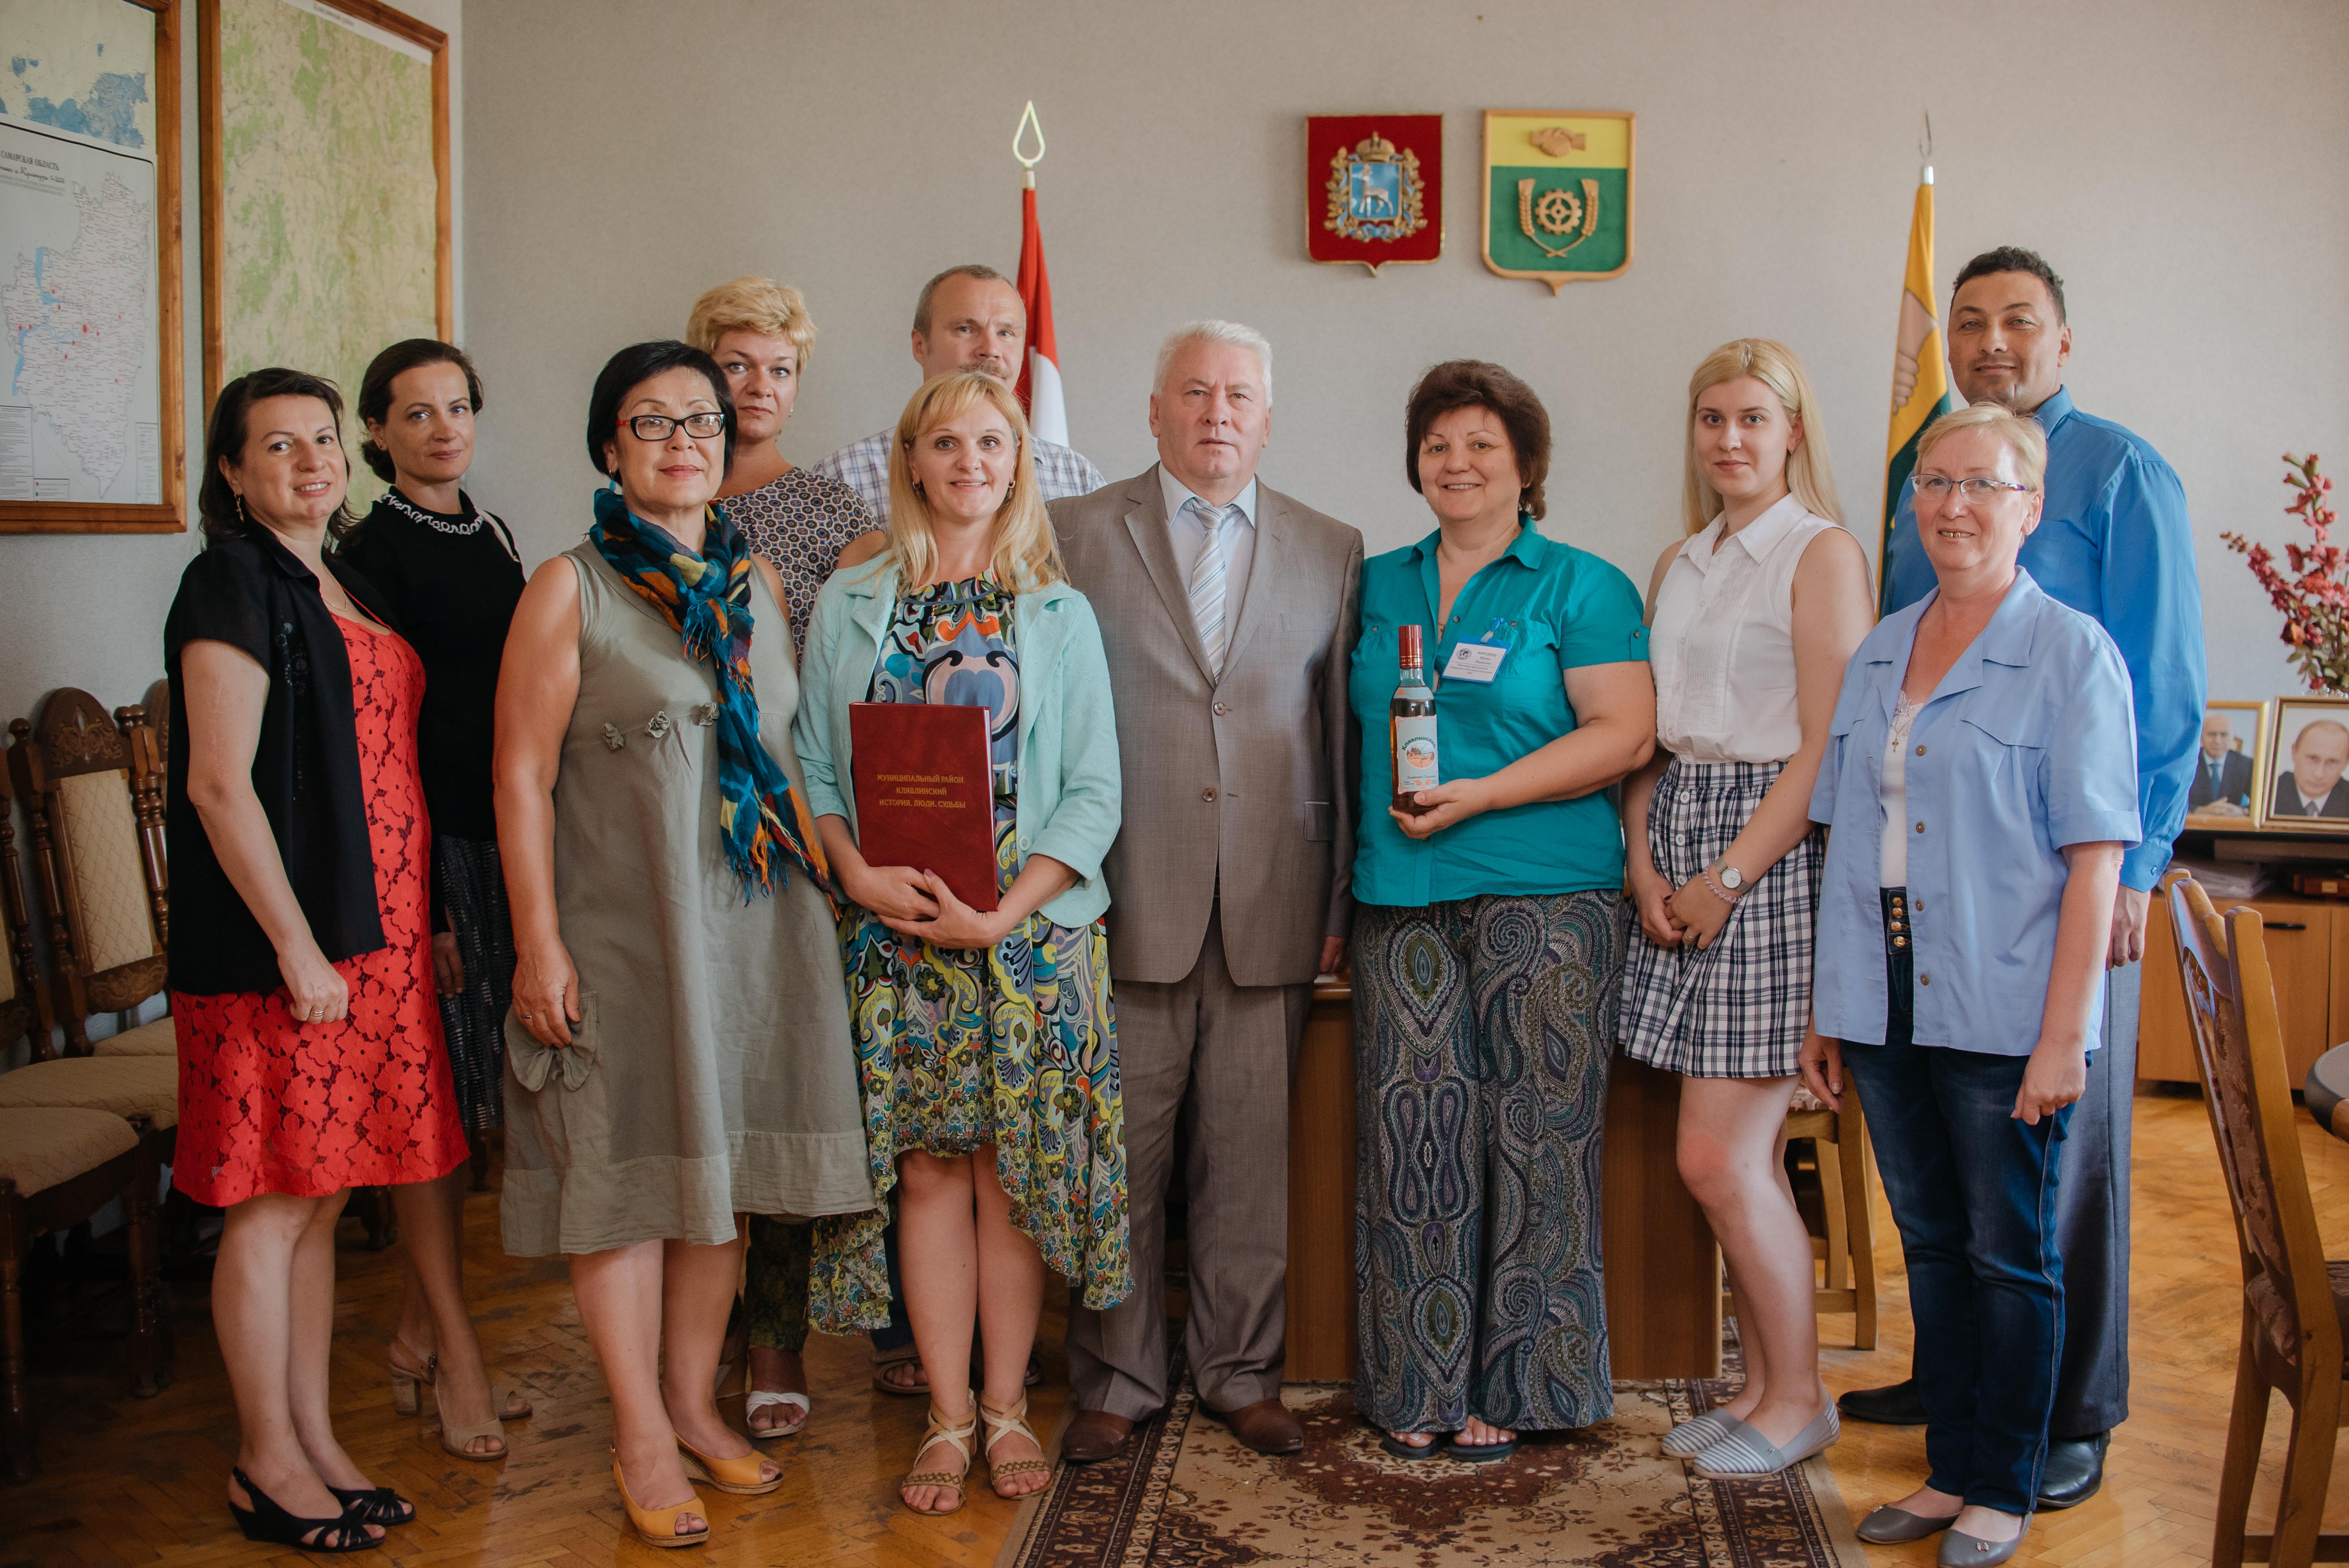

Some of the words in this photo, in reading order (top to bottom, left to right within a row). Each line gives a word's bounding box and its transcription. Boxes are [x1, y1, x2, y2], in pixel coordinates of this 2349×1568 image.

[1, 150, 33, 165] САМАРСКАЯ
[34, 158, 59, 170] ОБЛАСТЬ
[877, 774, 940, 782] МУНИЦИПАЛЬНЫЙ
[941, 775, 964, 783] РАЙОН
[896, 787, 947, 795] КЛЯВЛИНСКИЙ
